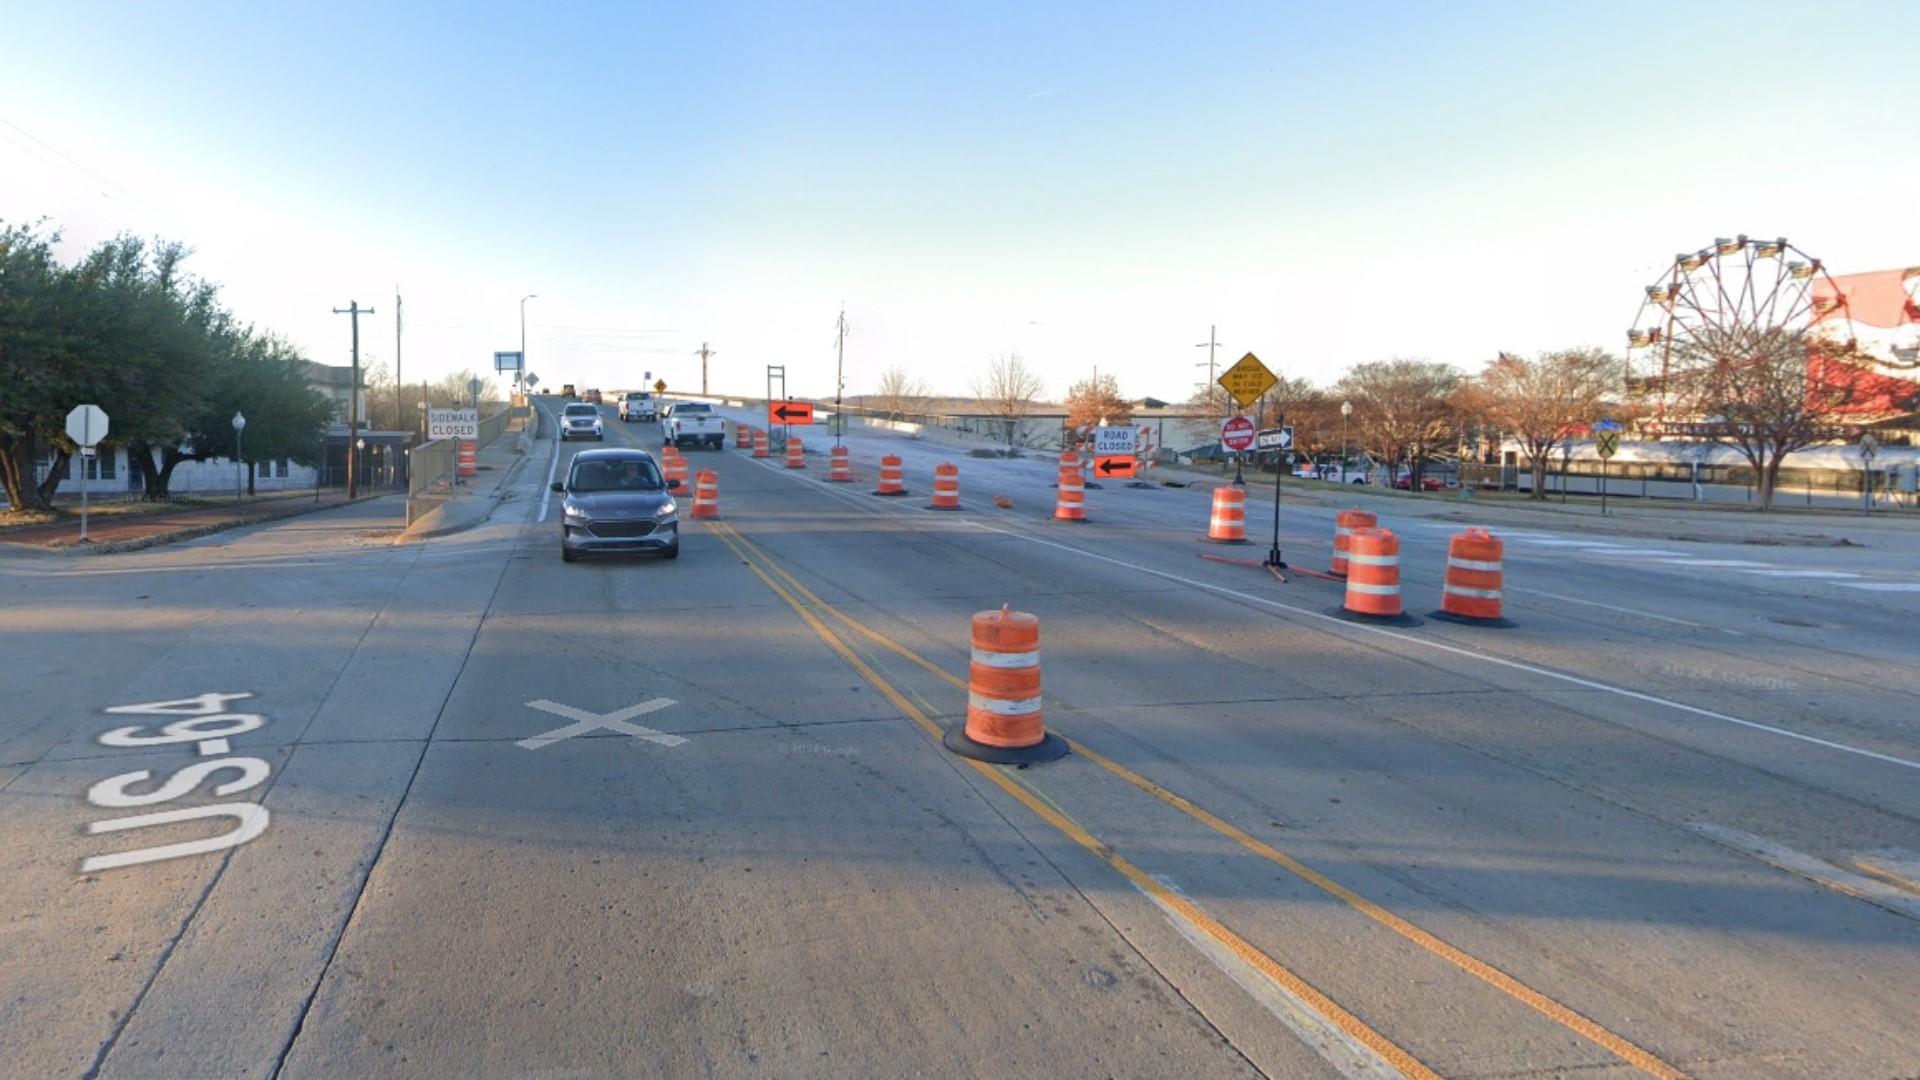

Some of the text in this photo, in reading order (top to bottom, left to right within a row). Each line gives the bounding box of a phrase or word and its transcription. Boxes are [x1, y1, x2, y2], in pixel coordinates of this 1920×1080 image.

[430, 412, 475, 422] SIDEWALK
[432, 425, 474, 435] CLOSED
[1103, 431, 1128, 440] ROAD
[1098, 442, 1133, 450] CLOSED
